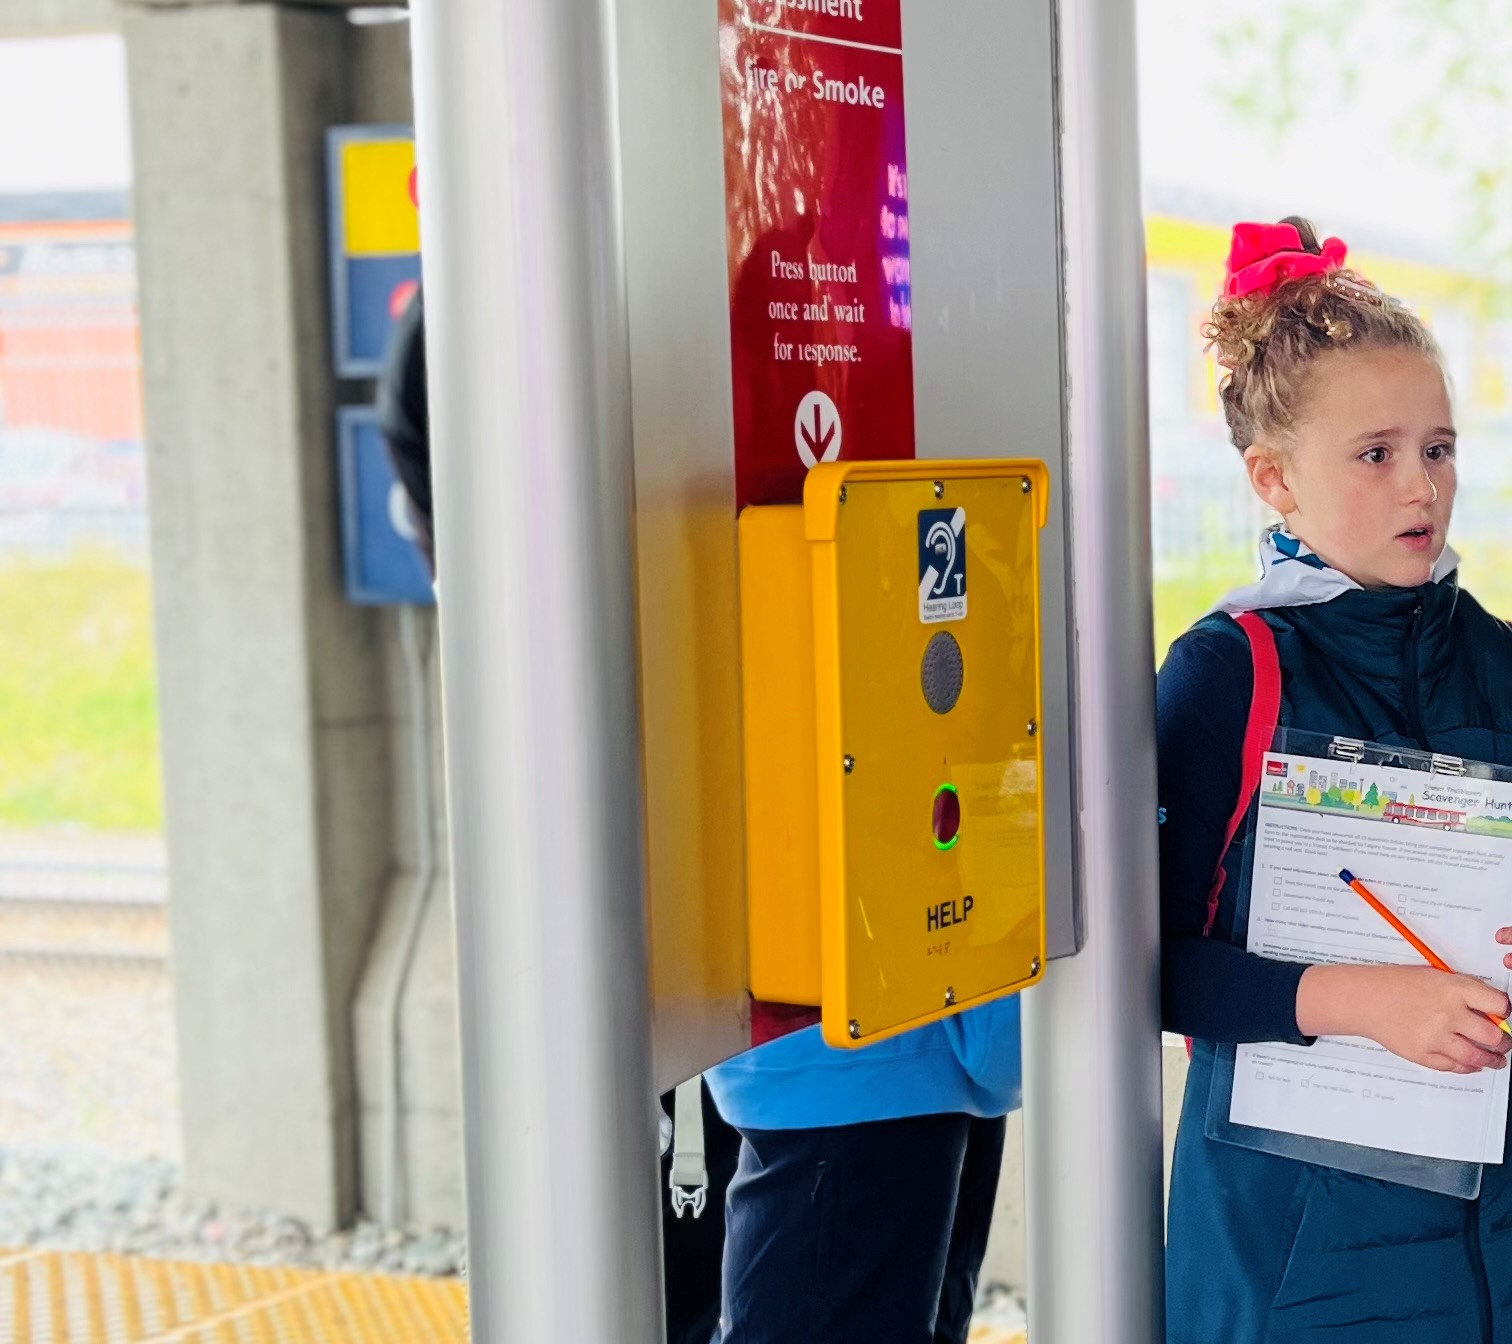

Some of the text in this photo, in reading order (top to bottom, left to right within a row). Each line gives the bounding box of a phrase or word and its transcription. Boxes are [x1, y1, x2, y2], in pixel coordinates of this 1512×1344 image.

[784, 71, 807, 93] or
[812, 70, 885, 109] Smoke
[770, 250, 858, 284] Press button
[768, 296, 865, 324] once and wait
[773, 332, 862, 368] for response.
[923, 599, 964, 613] Hearing Loop
[1421, 789, 1481, 809] Scavenger
[926, 894, 975, 933] HELP
